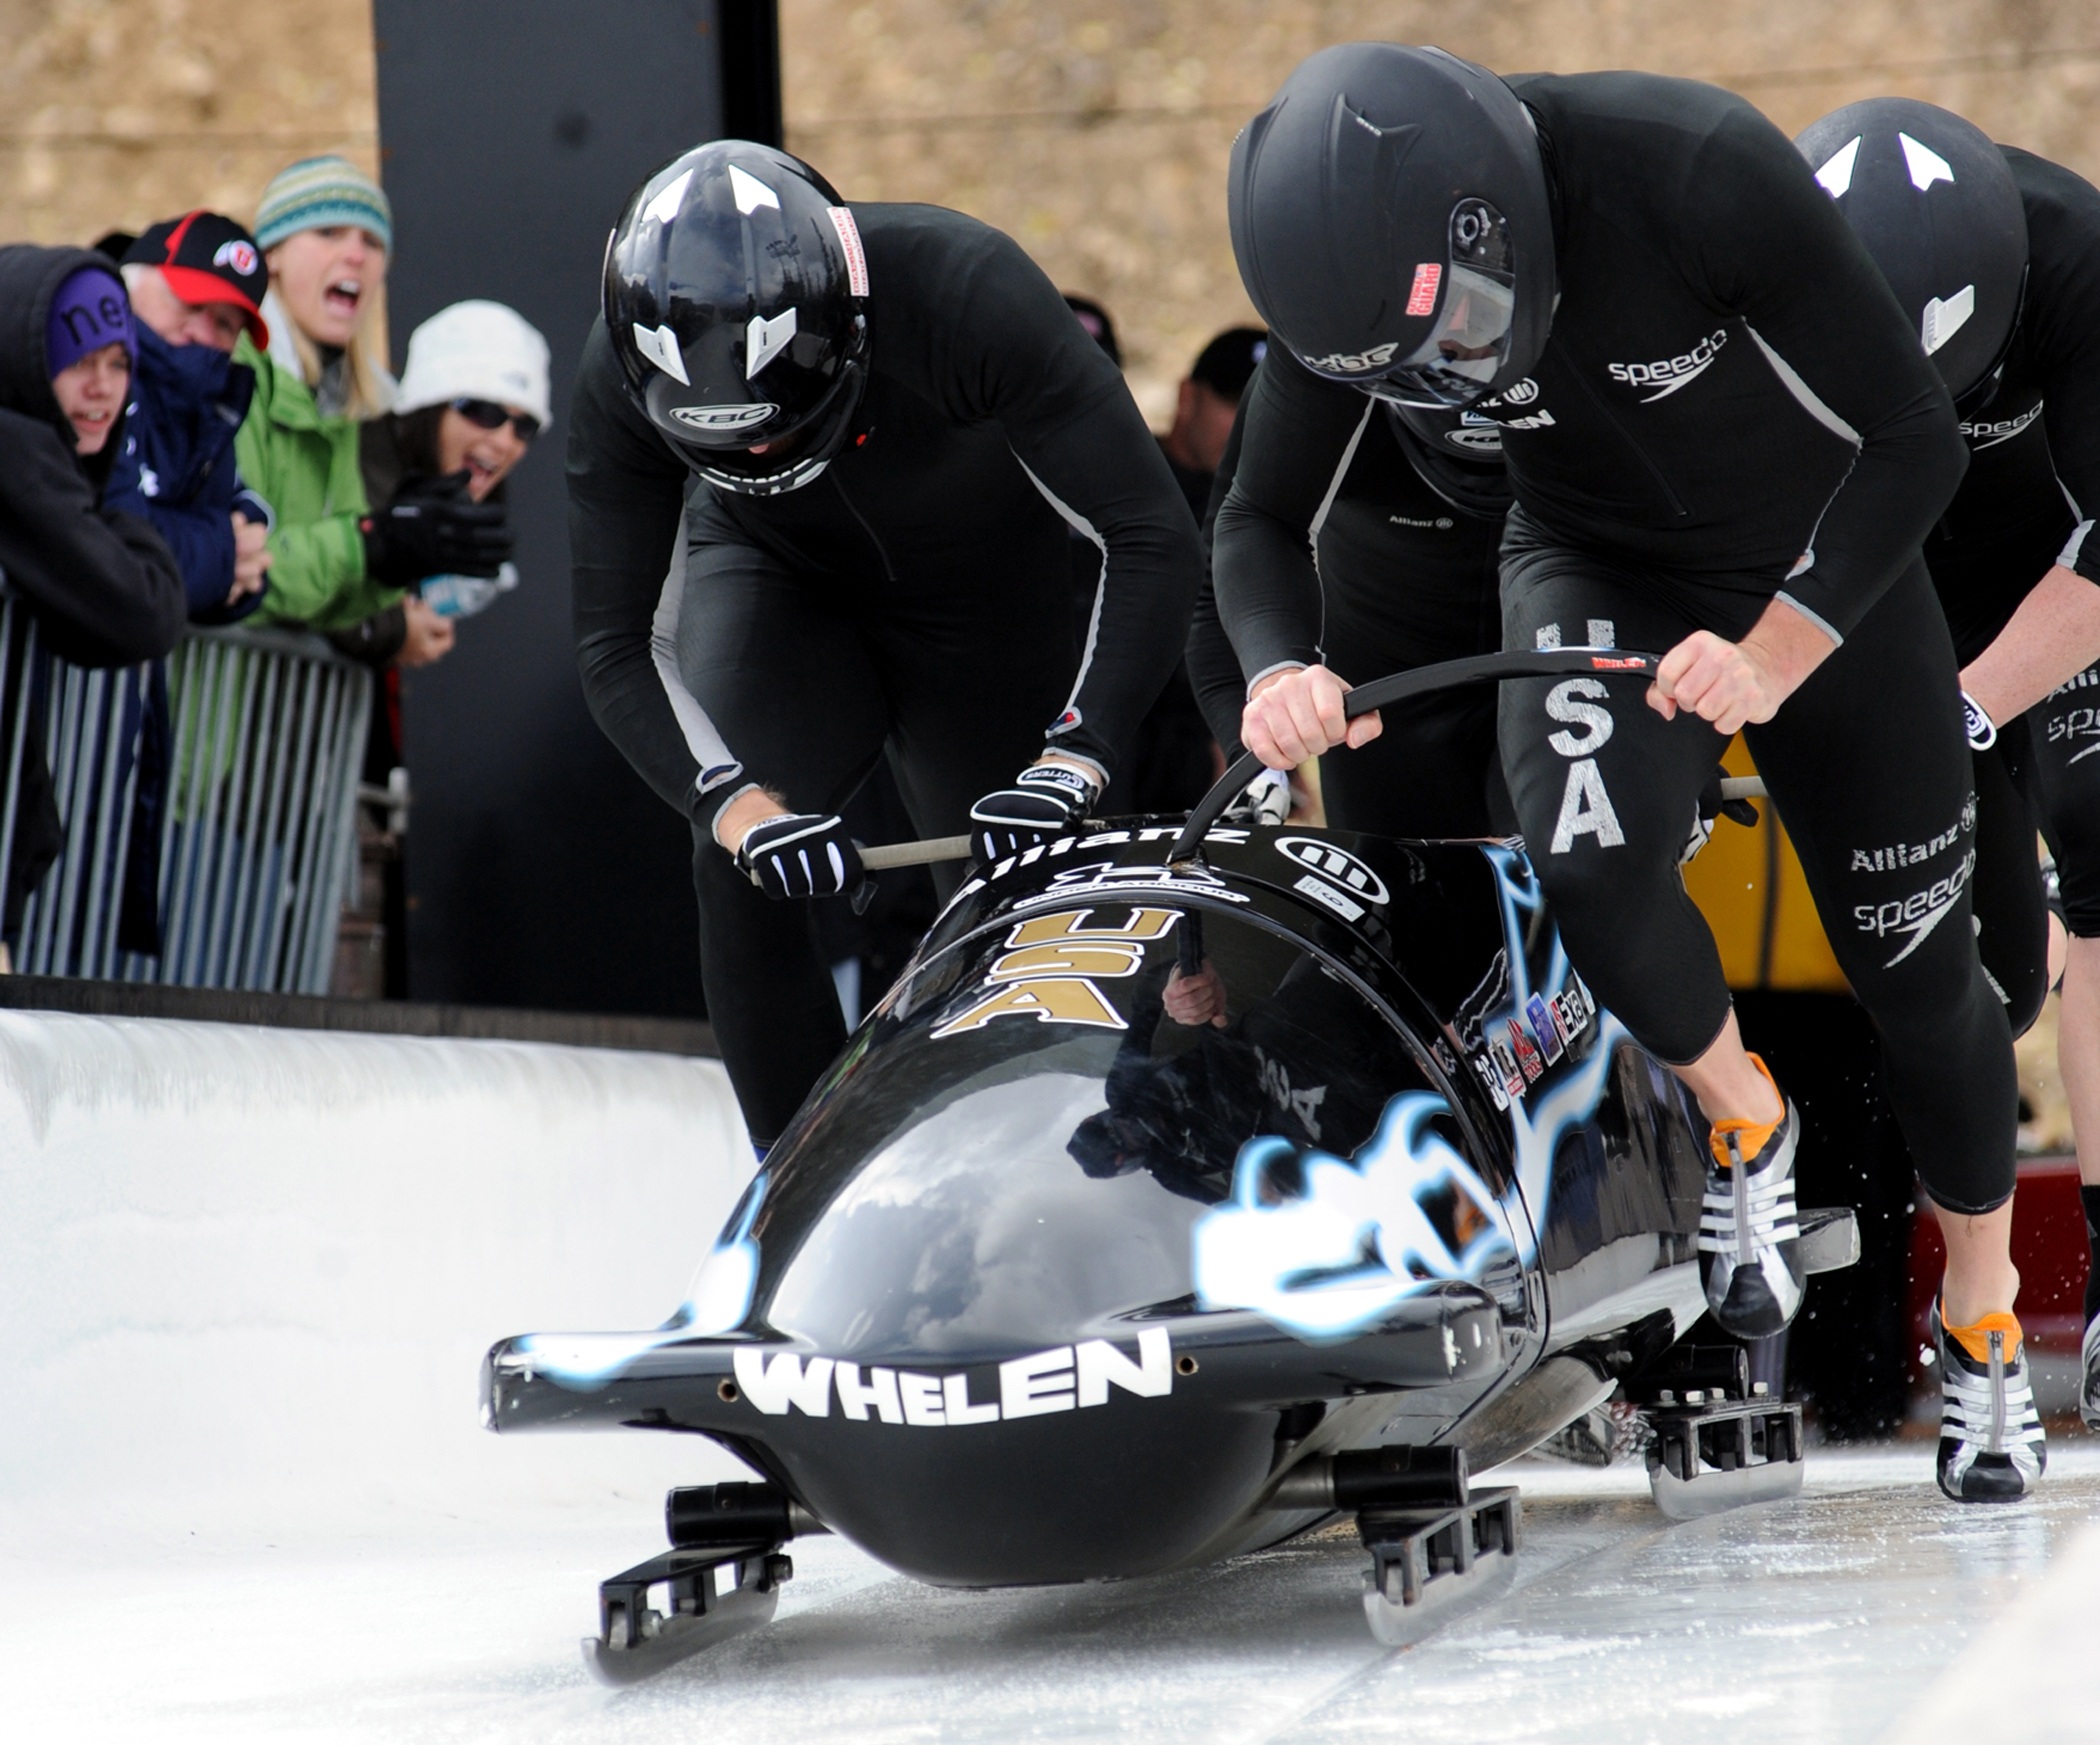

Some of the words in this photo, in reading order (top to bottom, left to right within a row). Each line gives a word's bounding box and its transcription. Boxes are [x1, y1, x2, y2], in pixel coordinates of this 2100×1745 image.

[1416, 264, 1441, 315] GUARD
[1608, 329, 1727, 387] speedo
[678, 403, 772, 425] KBC
[1959, 399, 2044, 438] speed
[1389, 515, 1433, 528] Allianz
[1851, 823, 1958, 872] Allianz
[1020, 881, 1109, 907] UNDER
[1115, 880, 1238, 901] ARMOUR
[1854, 848, 1976, 938] speedo
[929, 907, 1186, 1040] USA
[733, 1327, 1172, 1426] WHELEN
